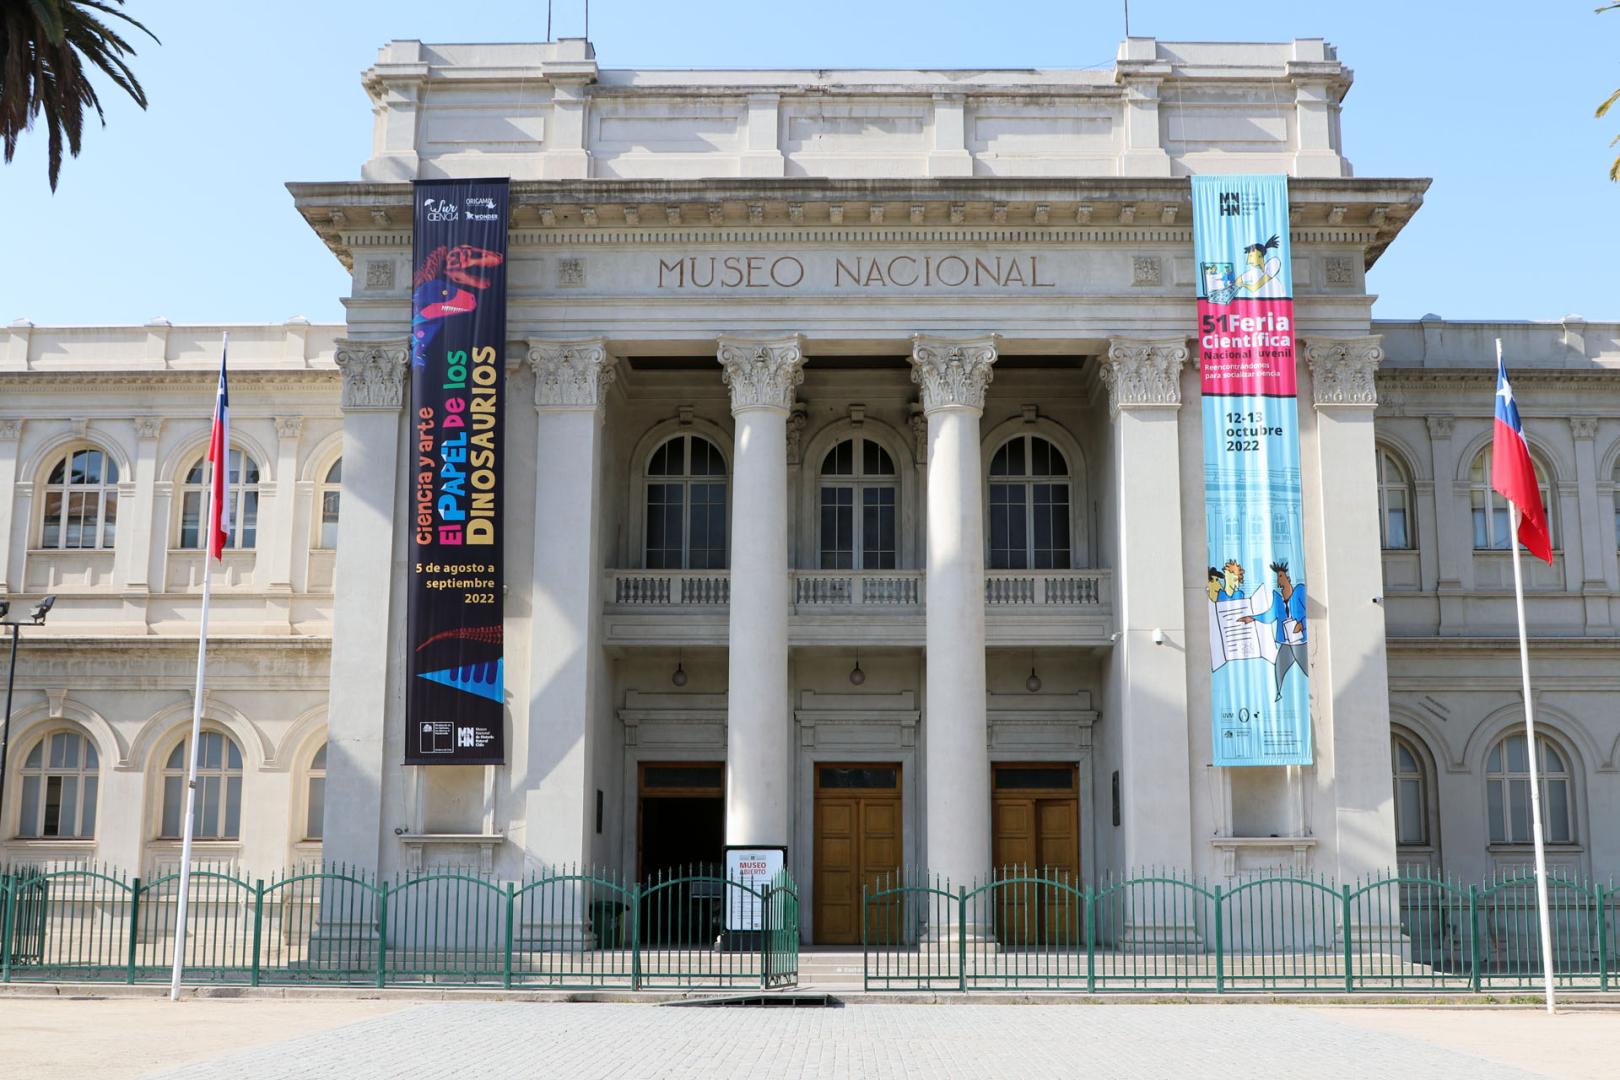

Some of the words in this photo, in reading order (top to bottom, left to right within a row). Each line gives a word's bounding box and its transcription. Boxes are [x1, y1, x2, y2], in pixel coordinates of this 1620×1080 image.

[657, 256, 804, 288] MUSEO
[834, 255, 1056, 288] NACIONAL
[1229, 312, 1290, 332] Feria
[1202, 331, 1291, 349] Científica
[1204, 350, 1252, 361] Nacional
[443, 350, 468, 389] los
[1226, 412, 1263, 424] 12-13
[417, 407, 434, 452] arte
[1226, 426, 1283, 437] octubre
[466, 345, 497, 545] DINOSAURIOS
[1226, 441, 1260, 451] 2022
[420, 456, 435, 468] y
[438, 432, 467, 521] PAPEL
[416, 472, 433, 545] Ciencia
[438, 524, 463, 545] El
[415, 563, 423, 573] 5
[425, 562, 441, 573] de
[443, 563, 485, 575] agosto
[487, 564, 495, 573] a
[426, 577, 495, 590] septiembre
[464, 593, 495, 604] 2022
